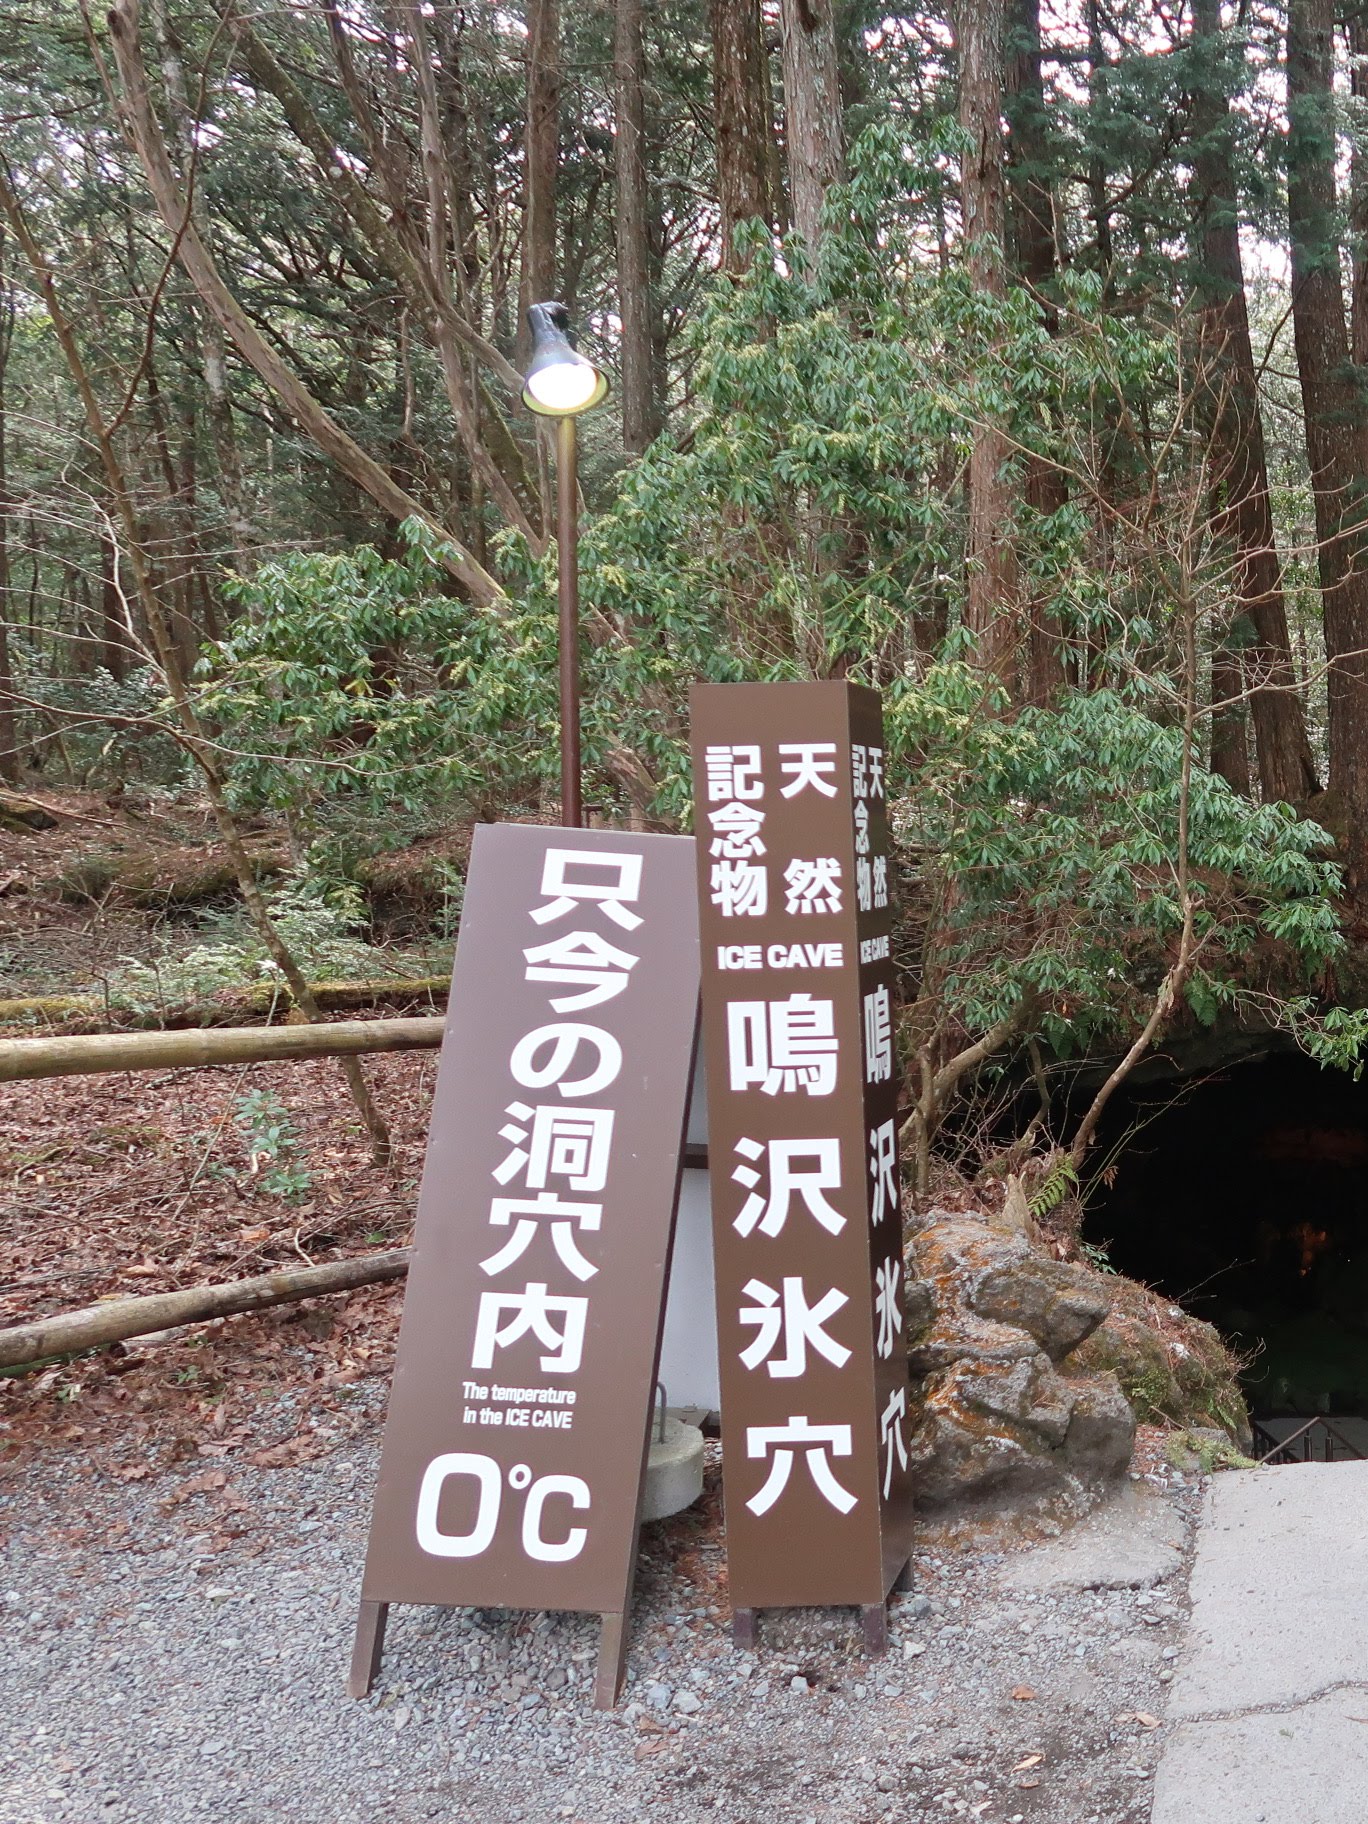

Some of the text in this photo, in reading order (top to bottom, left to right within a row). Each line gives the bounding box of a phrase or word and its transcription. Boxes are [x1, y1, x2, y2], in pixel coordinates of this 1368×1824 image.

[704, 744, 768, 917] 記念物
[778, 742, 844, 915] 天然
[717, 942, 844, 970] ICE CAVE
[471, 847, 645, 1373] 只今の洞穴内
[727, 993, 859, 1518] 鳴沢氷穴
[862, 983, 909, 1501] 鳴沢氷穴
[462, 1381, 577, 1404] The temperature
[463, 1406, 574, 1429] in the ICE CAVE
